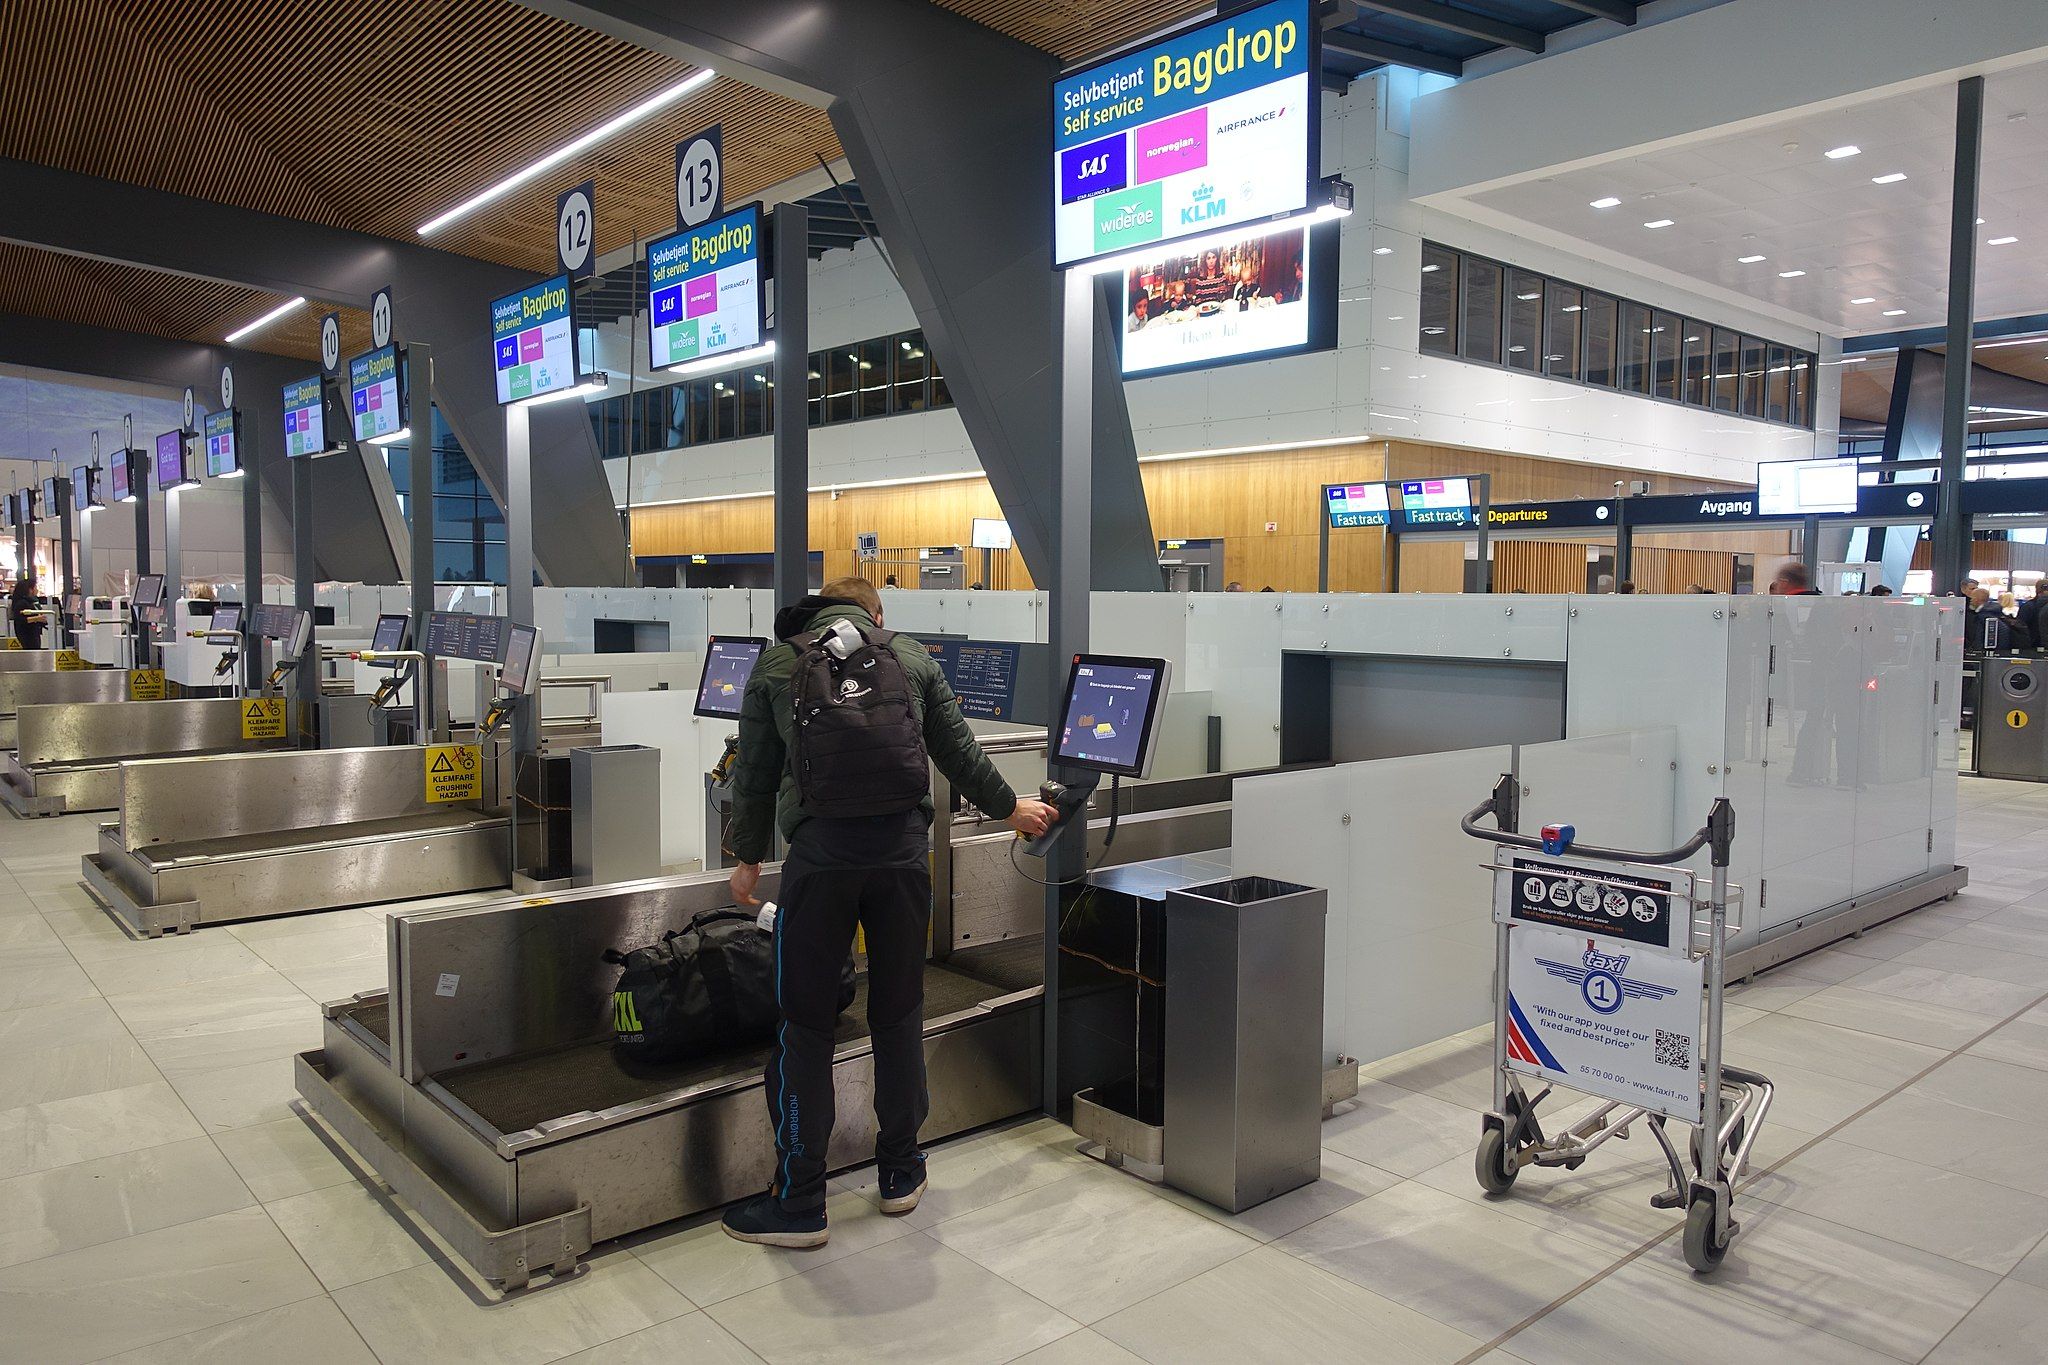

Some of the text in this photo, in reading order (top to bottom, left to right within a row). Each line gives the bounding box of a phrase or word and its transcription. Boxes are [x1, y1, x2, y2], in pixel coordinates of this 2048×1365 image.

[1153, 20, 1297, 97] Bagdrop
[1064, 67, 1144, 111] Selvbetjent
[1064, 96, 1144, 136] Self service
[1216, 110, 1276, 135] AIRFRANCE
[1146, 137, 1194, 158] norwegian
[1077, 153, 1110, 180] SAS
[684, 158, 713, 208] 13
[1181, 198, 1226, 225] KLM
[564, 209, 587, 252] 12
[653, 242, 689, 267] Selvbetjent
[691, 222, 753, 265] Bagdrop
[653, 260, 689, 283] Self service
[494, 301, 522, 320] Selvbetjent
[522, 286, 567, 320] Bagdrop
[660, 297, 675, 312] SAS
[375, 306, 388, 337] 11
[324, 330, 337, 358] 10
[502, 345, 513, 358] SAS
[706, 332, 727, 349] KLM
[224, 378, 230, 398] 9
[1337, 512, 1385, 526] Fast track
[1411, 510, 1435, 523] Fast
[1436, 508, 1465, 521] track
[1488, 509, 1548, 524] Departures
[1700, 499, 1752, 516] Avgang
[432, 773, 475, 783] KLEMFARE
[435, 783, 473, 792] CRUSHING
[439, 791, 469, 799] HAZARD
[1584, 949, 1629, 973] taxi
[1594, 980, 1610, 1002] 1
[1540, 1018, 1563, 1031] fixed
[1564, 1026, 1582, 1036] and
[1582, 1030, 1604, 1042] best
[1558, 1012, 1573, 1021] our
[1575, 1017, 1592, 1028] app
[1594, 1022, 1612, 1032] you
[1613, 1027, 1630, 1037] get
[1632, 1032, 1650, 1042] our
[1580, 1065, 1590, 1074] 55
[1592, 1068, 1601, 1077] 70
[1602, 1072, 1613, 1080] 00
[1615, 1075, 1625, 1084] 00
[1632, 1081, 1689, 1102] www.taxi1.no
